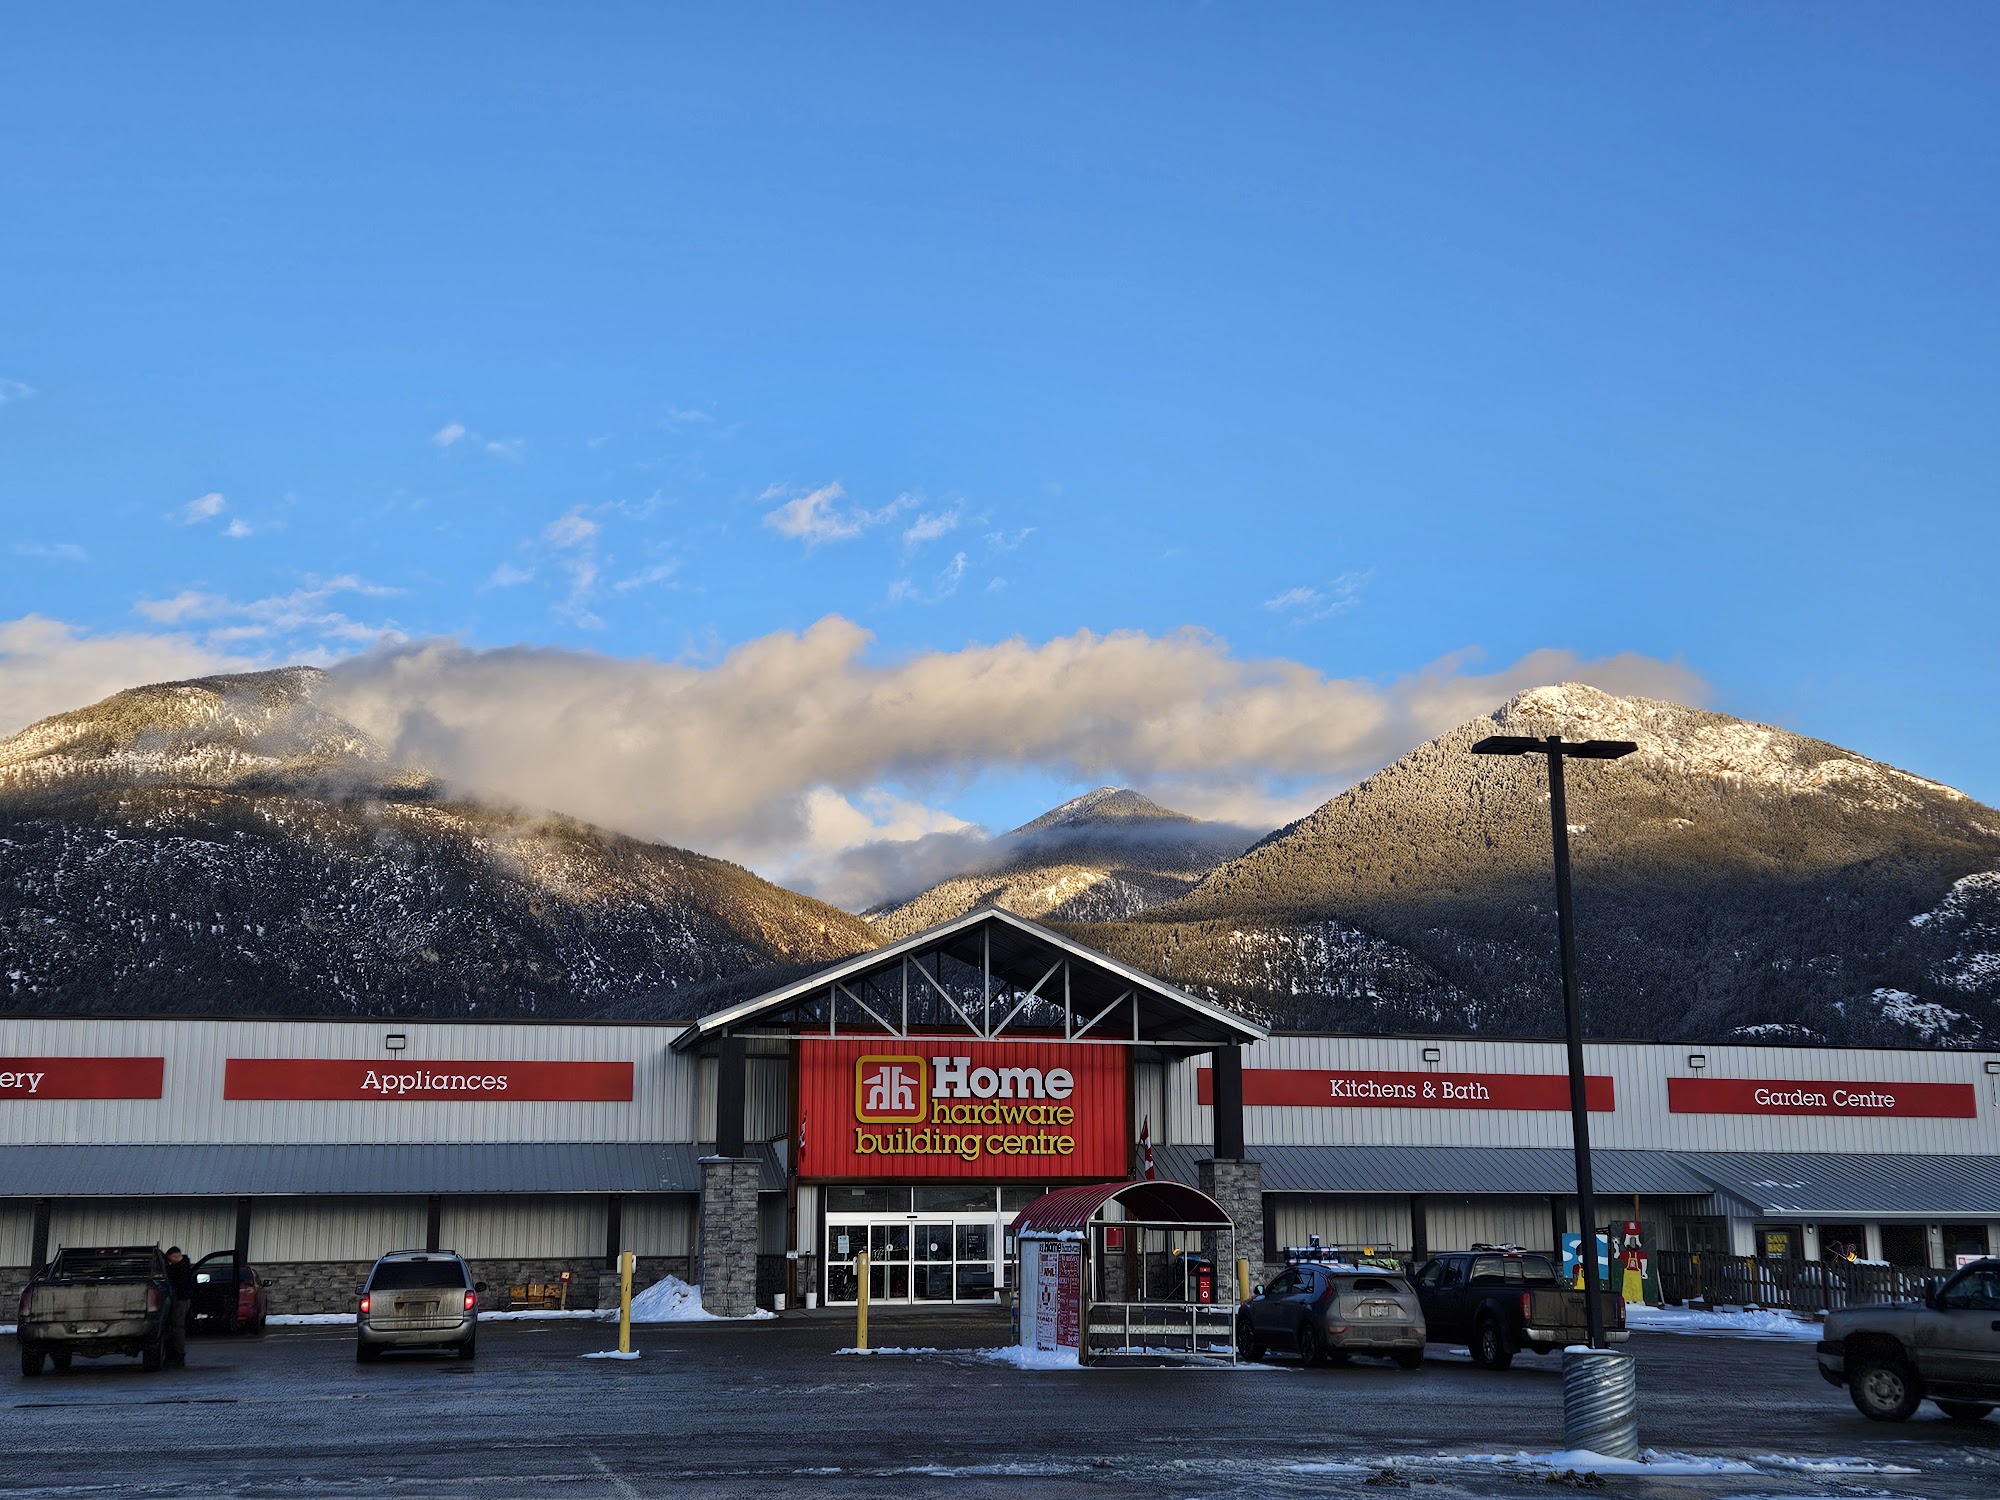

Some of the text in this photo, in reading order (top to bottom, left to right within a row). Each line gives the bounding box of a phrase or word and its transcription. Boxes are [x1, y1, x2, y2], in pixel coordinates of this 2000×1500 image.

[0, 1071, 45, 1093] ery
[360, 1070, 508, 1094] Appliances
[931, 1056, 1075, 1100] Home
[1329, 1079, 1490, 1100] Kitchens & Bath
[1754, 1088, 1896, 1108] Garden Centre
[931, 1098, 1075, 1126] hardware
[855, 1127, 1075, 1161] building centre
